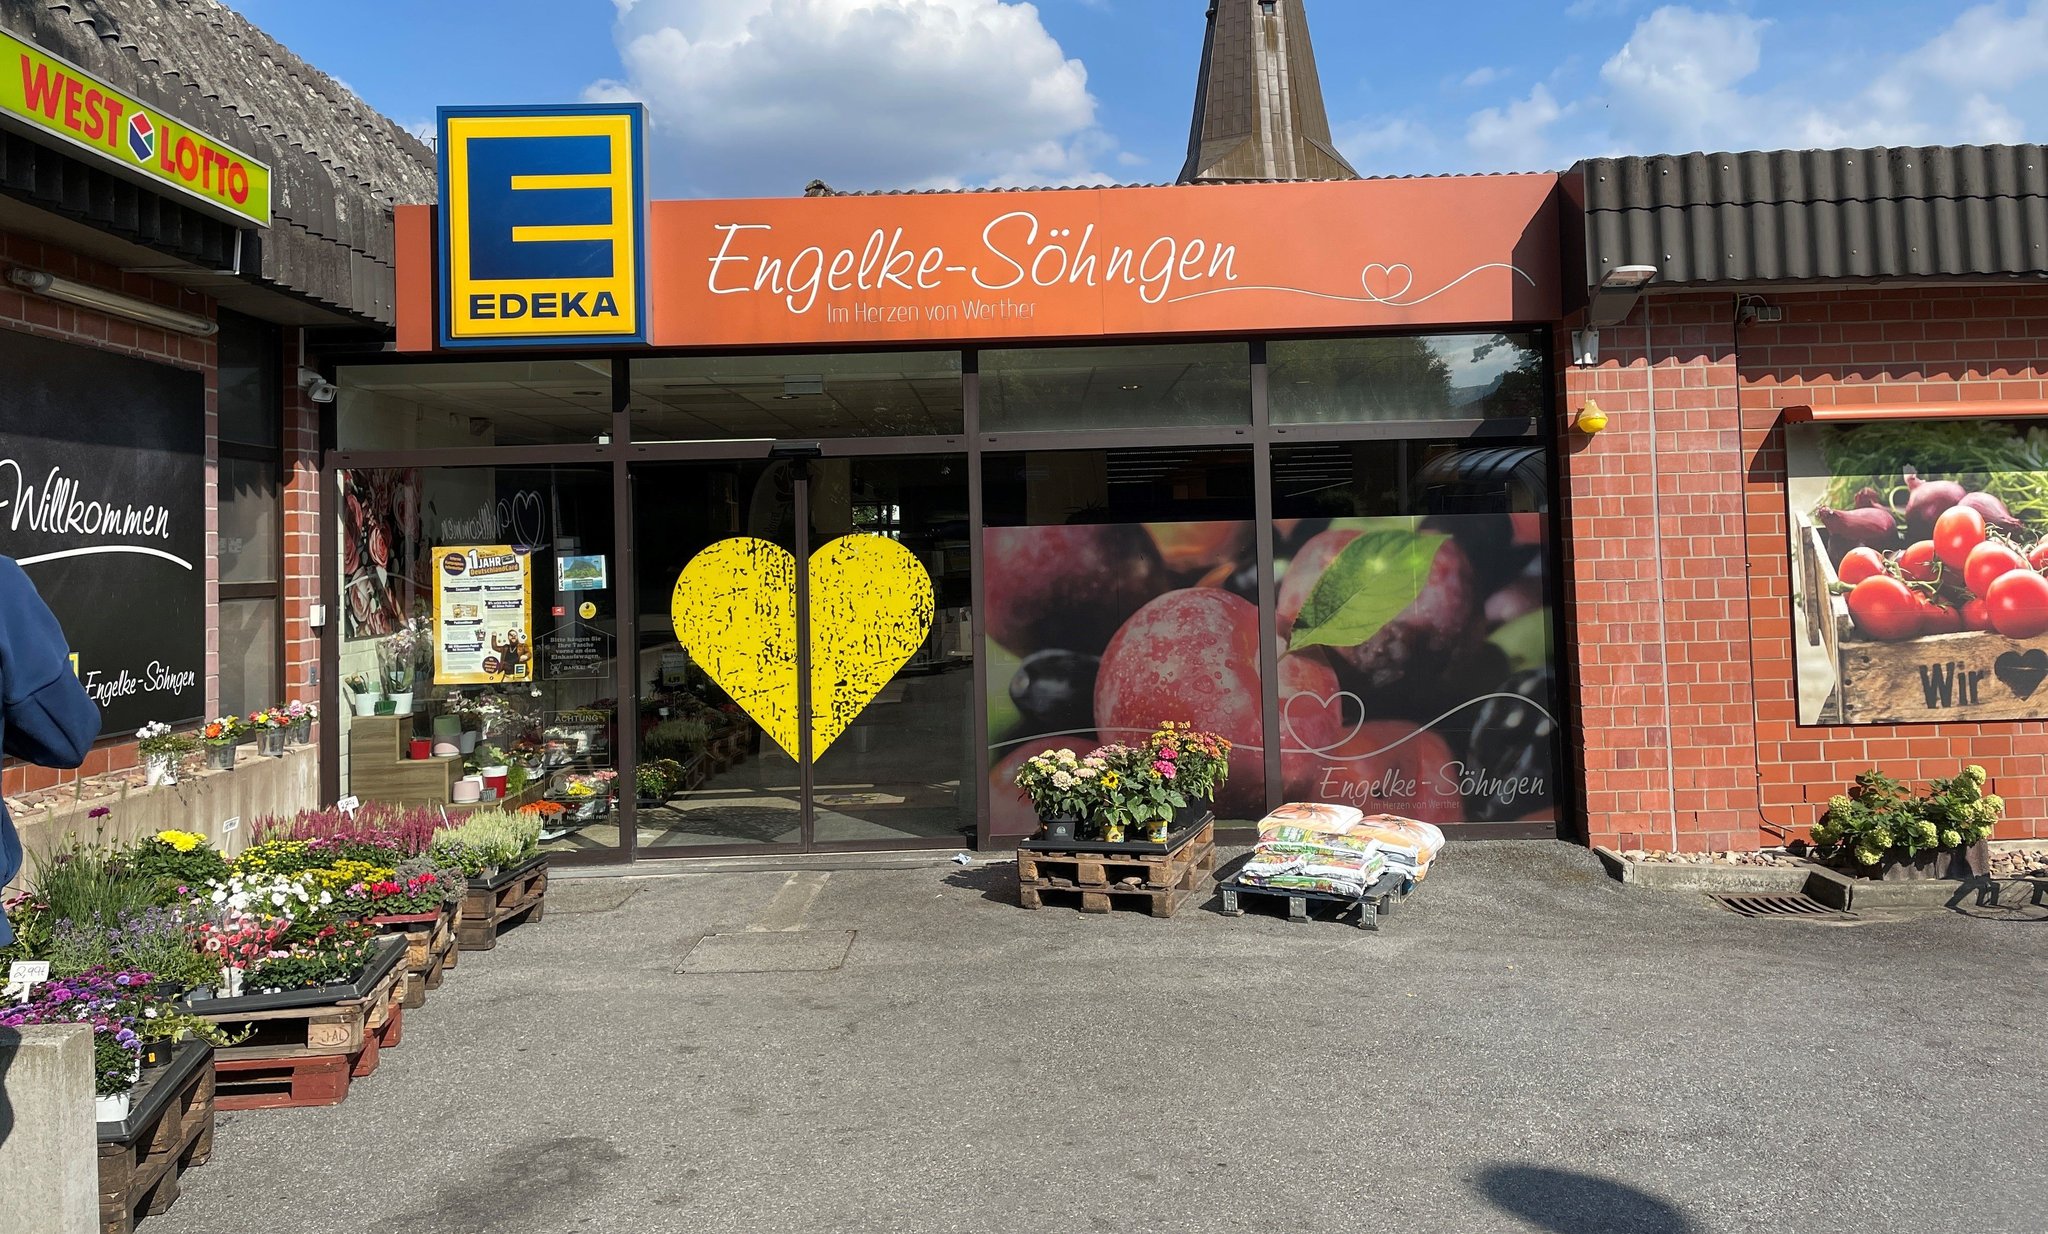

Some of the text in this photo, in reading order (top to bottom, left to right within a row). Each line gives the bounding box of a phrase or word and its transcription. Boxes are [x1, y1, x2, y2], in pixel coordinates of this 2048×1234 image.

[20, 53, 249, 205] WEST LOTTO
[708, 211, 1238, 314] Engelke-Söhngen
[469, 290, 619, 320] EDEKA
[827, 298, 1035, 324] Im Herzen von Werther
[0, 459, 170, 538] Willkommen
[468, 550, 478, 569] 1
[478, 556, 502, 568] JAHR
[470, 564, 519, 575] DeutschlandCard
[85, 660, 196, 707] Engelke-Söhngen
[1919, 661, 1986, 709] Wir
[1319, 761, 1545, 808] Engelke-Söhngen
[1371, 801, 1380, 809] Im
[1383, 801, 1410, 809] Herzen
[1428, 800, 1460, 809] Werther
